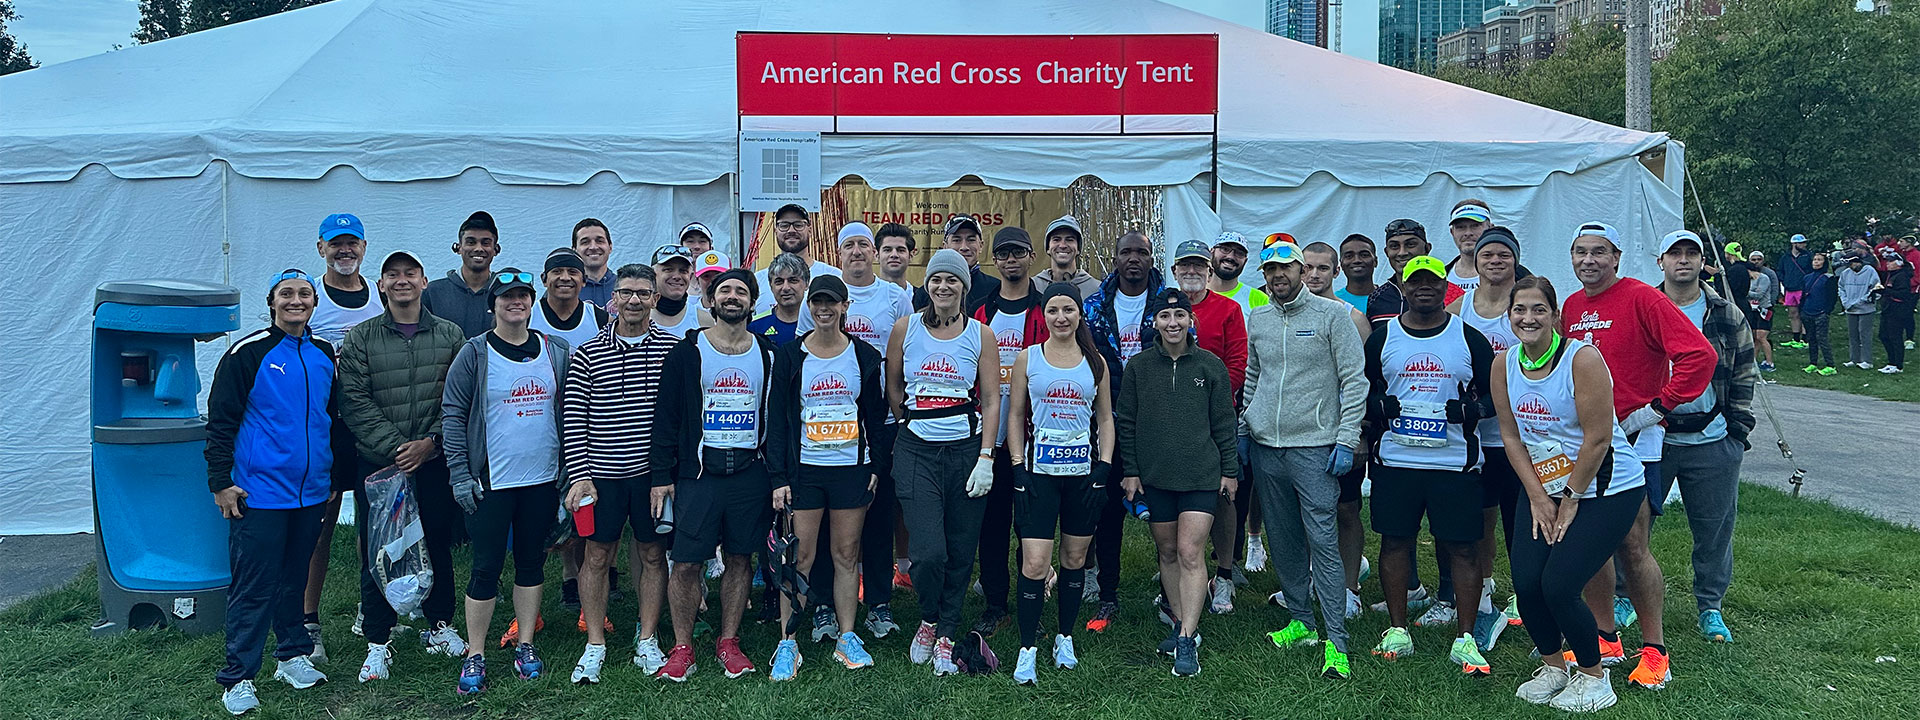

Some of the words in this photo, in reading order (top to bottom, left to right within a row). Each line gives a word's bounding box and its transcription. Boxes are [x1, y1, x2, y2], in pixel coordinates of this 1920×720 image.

[760, 62, 884, 84] American
[894, 62, 940, 84] Red
[950, 62, 1021, 84] Cross
[1036, 62, 1128, 89] Charity
[1136, 60, 1194, 83] Tent
[862, 212, 905, 224] TEAM
[910, 213, 942, 225] RED
[948, 213, 1004, 225] OSS
[1580, 310, 1599, 322] Santa
[1569, 320, 1613, 332] STAMPEDE
[706, 414, 714, 424] H
[718, 414, 754, 424] 44075
[1392, 418, 1401, 428] G
[1404, 419, 1444, 432] 38027
[808, 425, 817, 435] N
[821, 424, 856, 434] 67717
[1037, 447, 1043, 460] J
[1048, 447, 1087, 458] 45948
[1537, 456, 1570, 477] 56672
